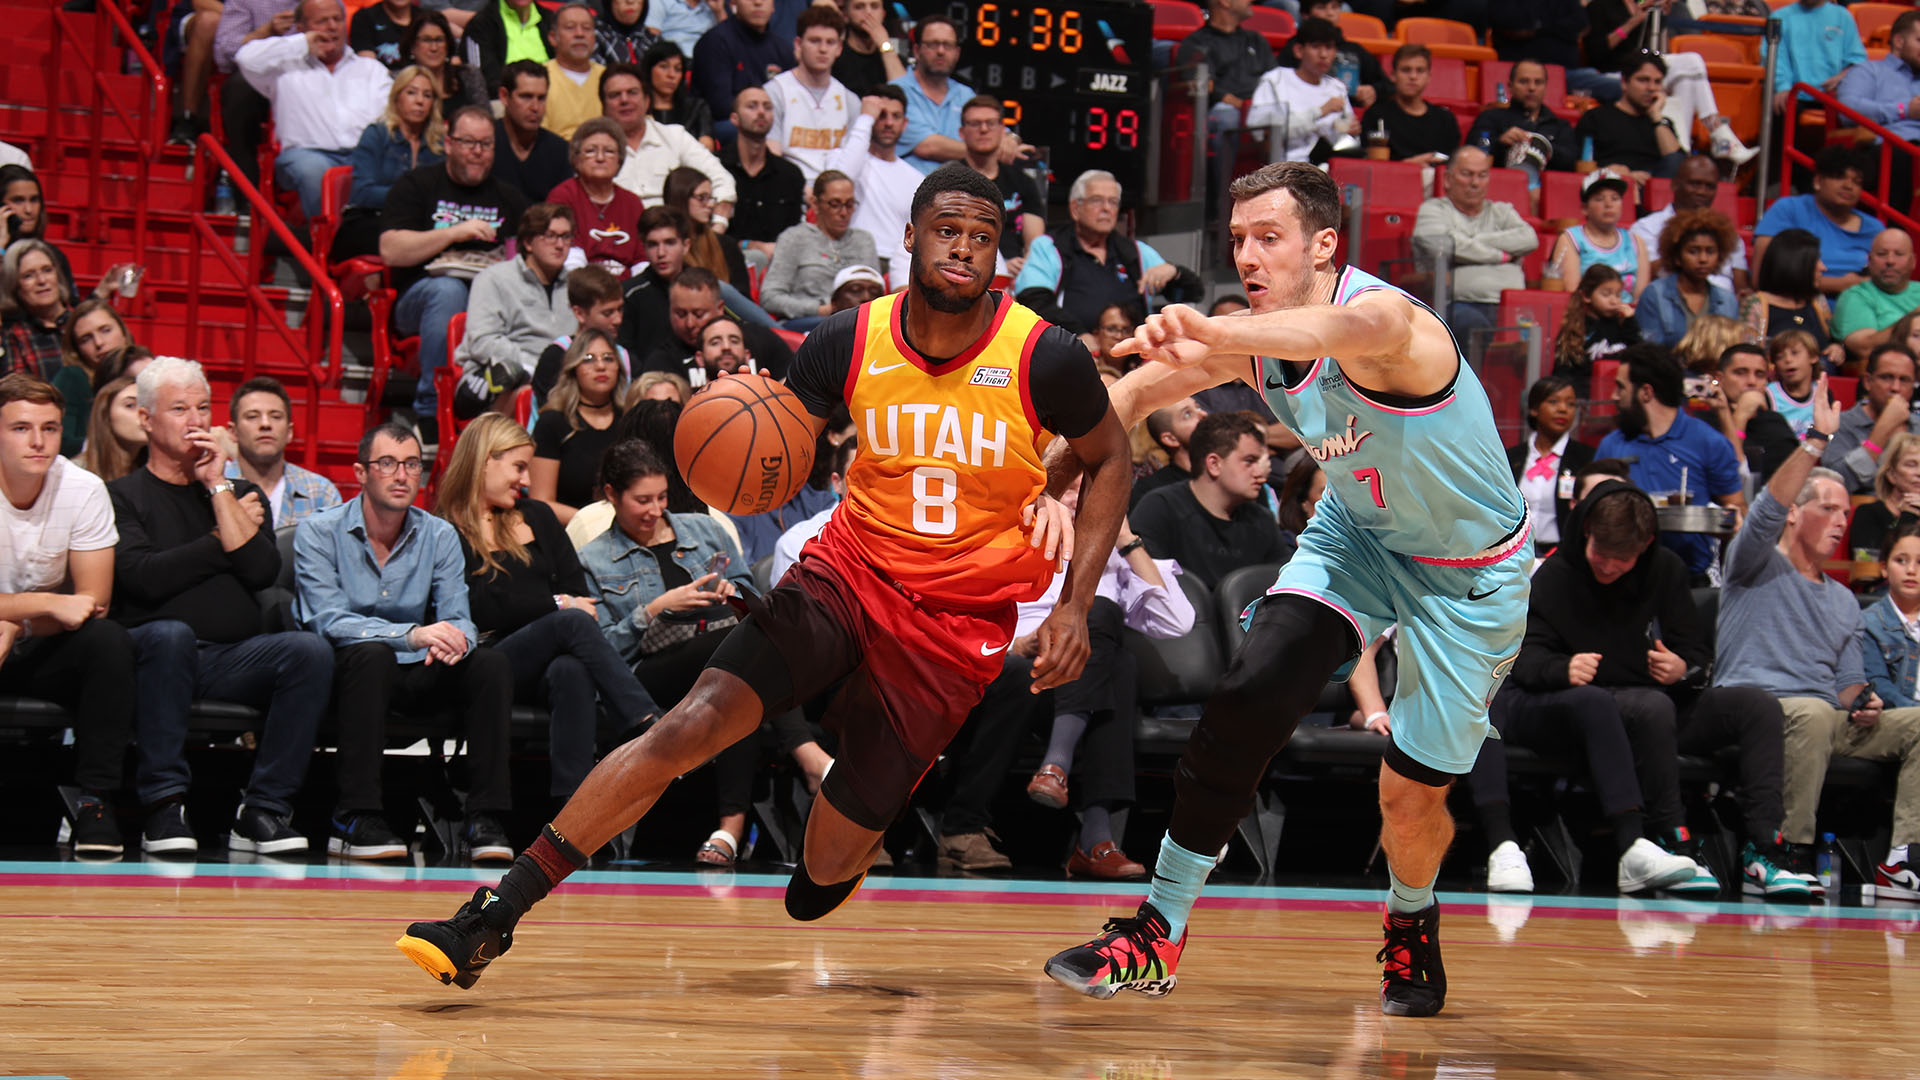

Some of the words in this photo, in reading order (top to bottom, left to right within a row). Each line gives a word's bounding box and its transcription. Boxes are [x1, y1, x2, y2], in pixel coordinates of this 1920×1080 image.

[976, 3, 1083, 53] 6:36
[1090, 73, 1128, 93] JAZZ
[1087, 107, 1139, 149] 39
[974, 368, 986, 383] 5
[985, 377, 1008, 385] FIGHT
[866, 403, 1007, 467] UTAH
[912, 466, 957, 534] 8
[1352, 467, 1388, 510] 7
